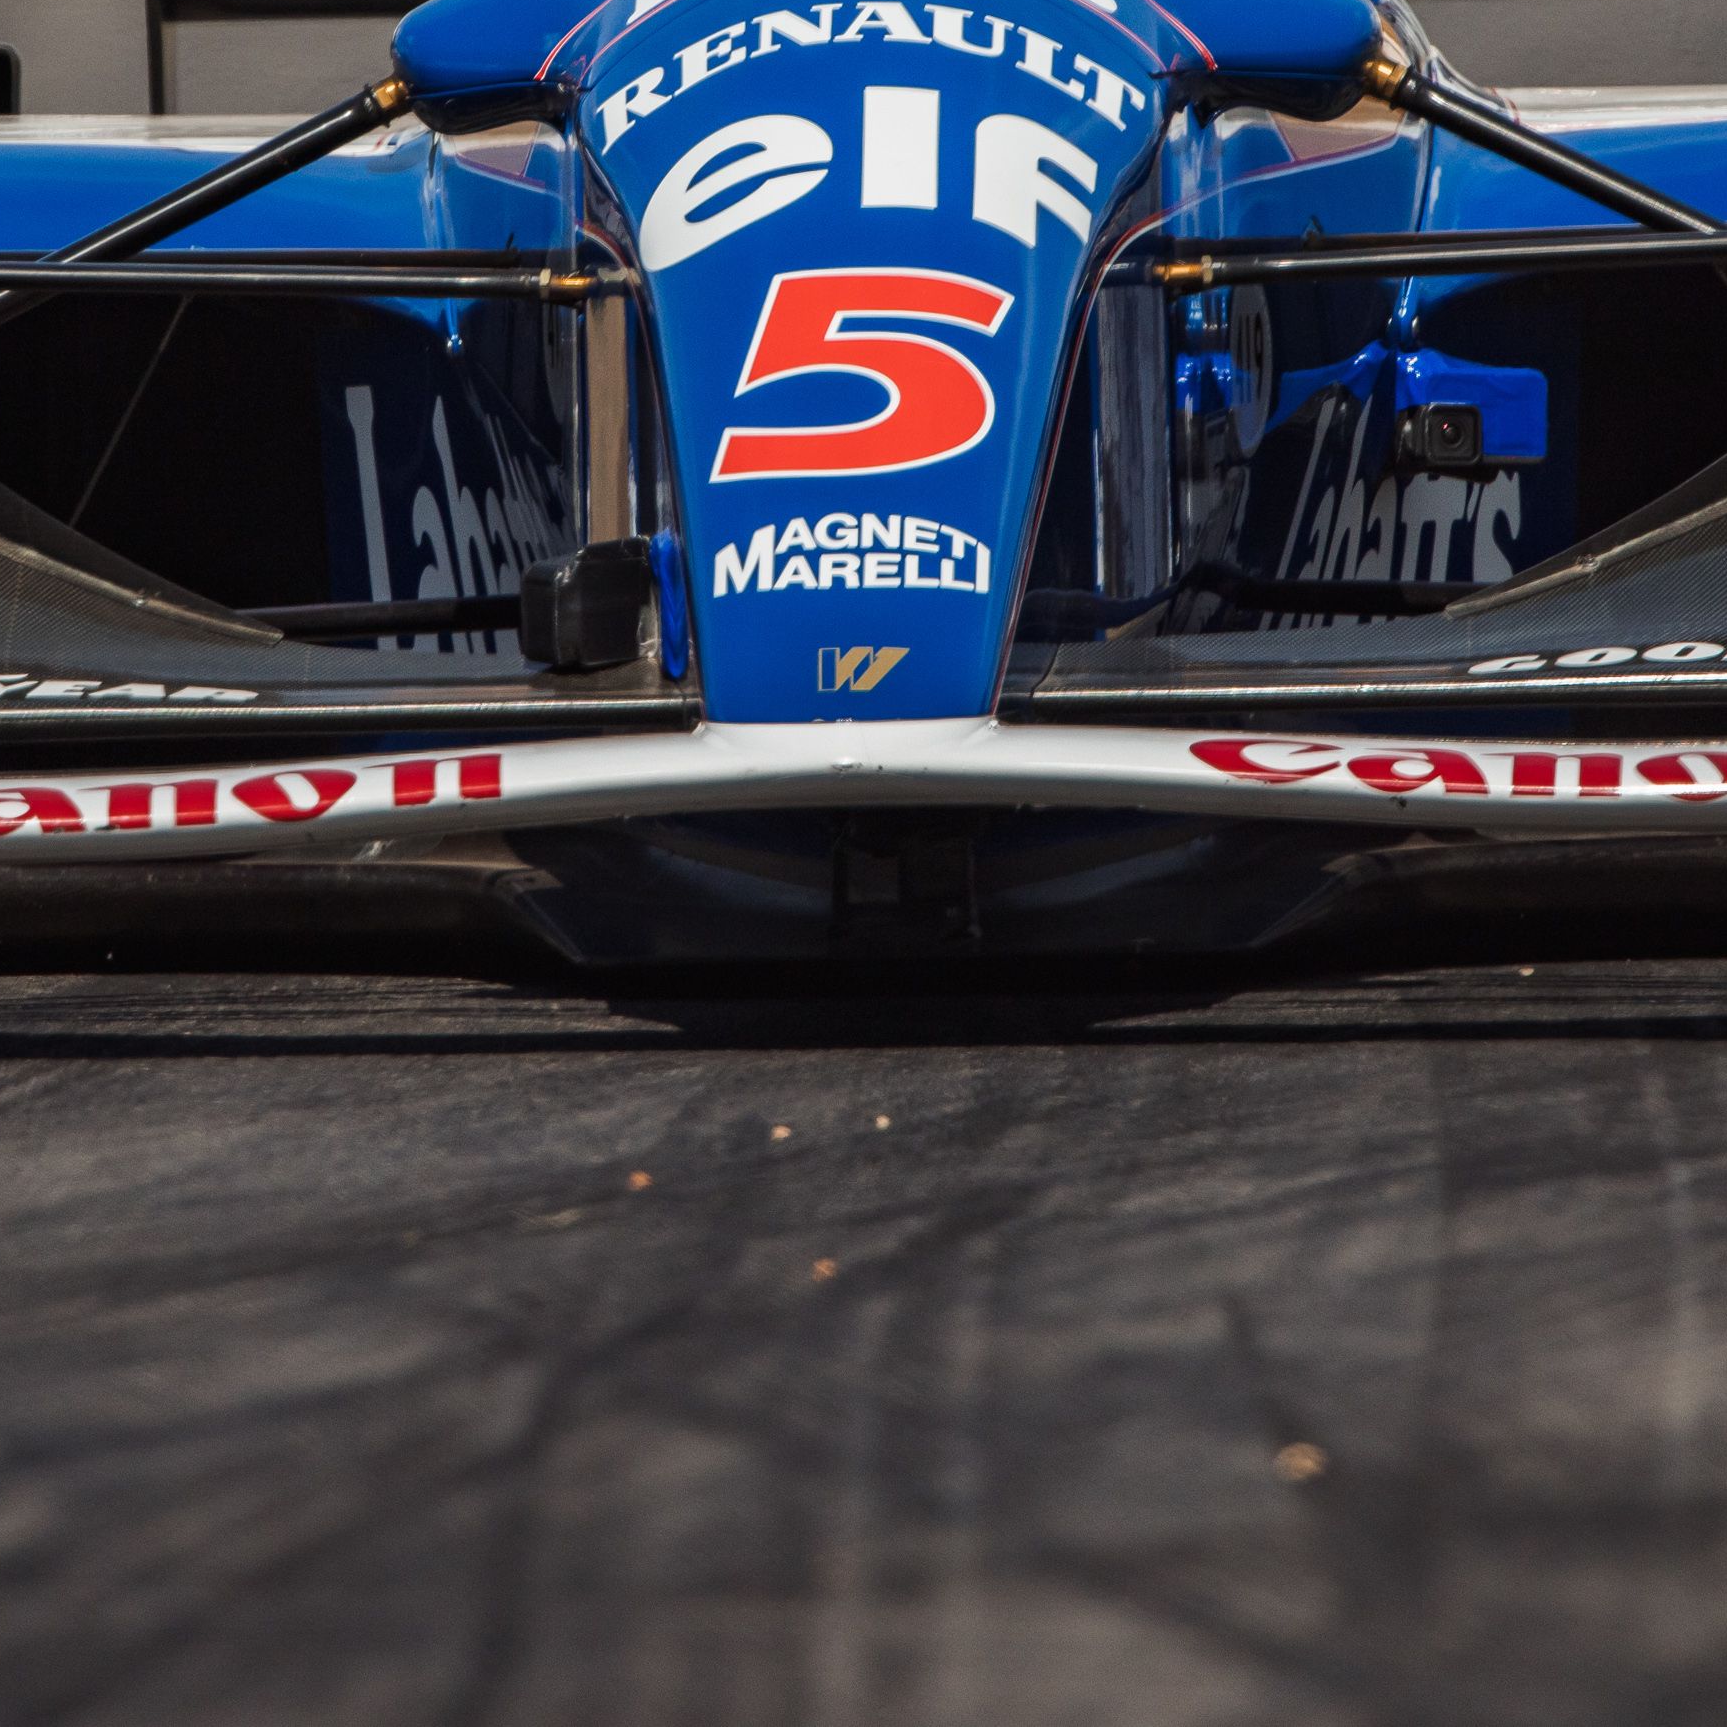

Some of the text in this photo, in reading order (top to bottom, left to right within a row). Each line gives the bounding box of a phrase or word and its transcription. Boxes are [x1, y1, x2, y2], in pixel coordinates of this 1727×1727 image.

[595, 1, 1146, 156] RENAULT
[639, 86, 1098, 272] elf
[708, 267, 1015, 483] 5
[713, 512, 991, 565] MAGNETI
[713, 545, 991, 598] MARELLI
